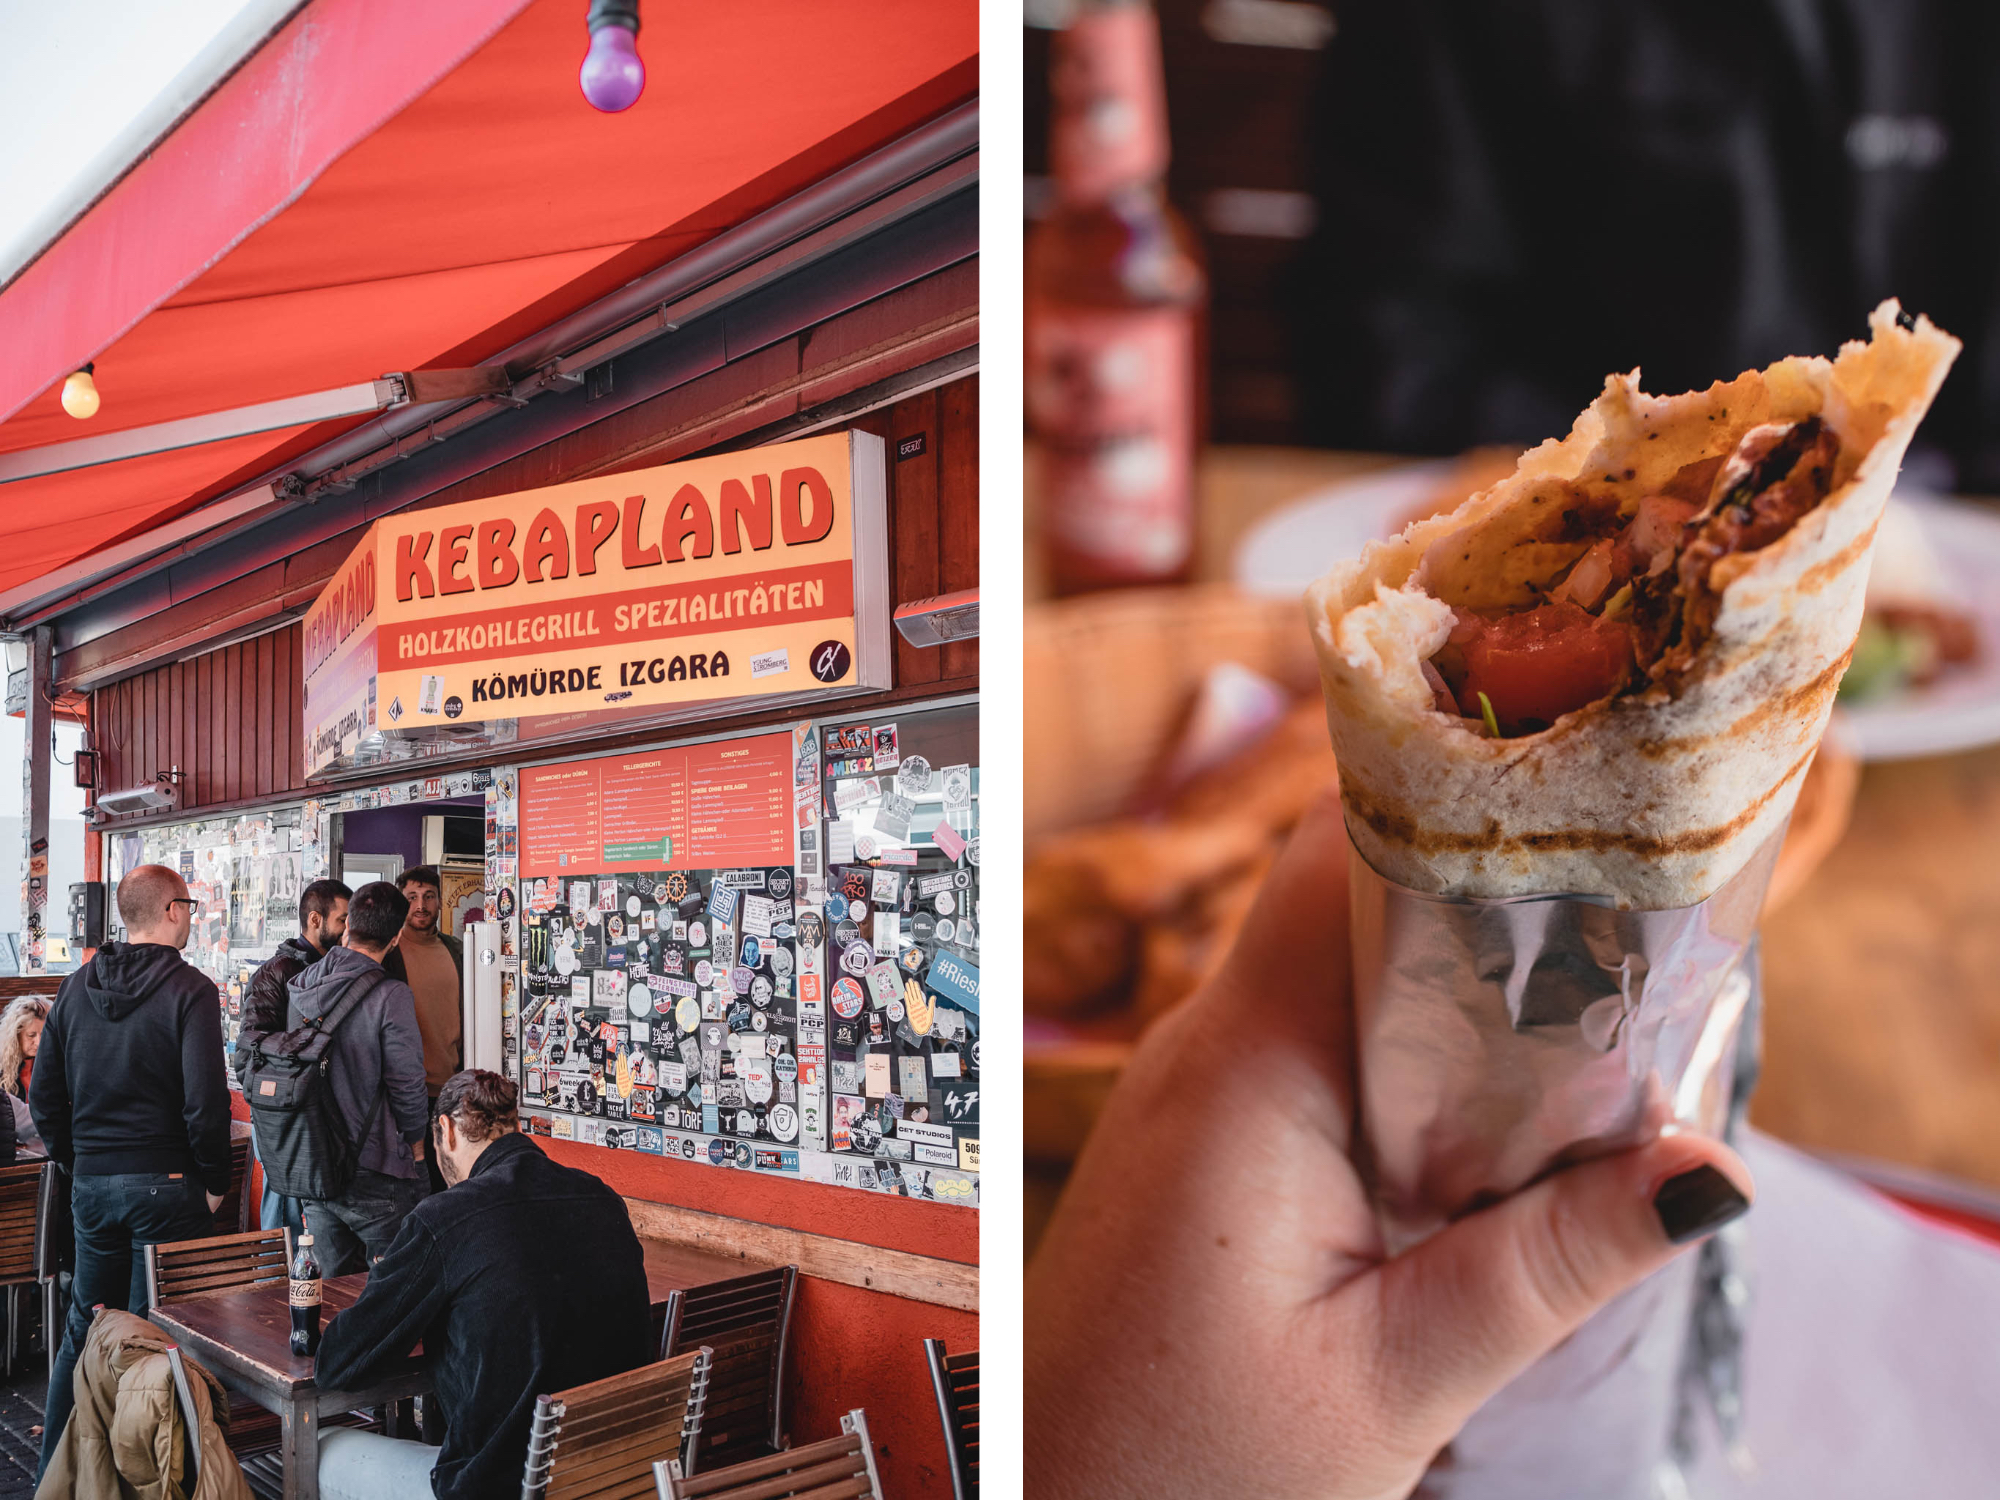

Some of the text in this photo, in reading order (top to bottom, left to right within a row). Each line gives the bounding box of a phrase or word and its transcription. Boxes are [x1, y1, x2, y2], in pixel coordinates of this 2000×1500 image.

[395, 466, 834, 604] KEBAPLAND
[305, 550, 376, 682] KEBAPLAND
[398, 579, 824, 659] HOLZKOHLEGRILL SPEZIALITÄTEN
[472, 650, 730, 702] KÖMÜRDE IZGARA
[721, 749, 749, 758] SONSTIGES
[623, 761, 662, 771] TELLERGERICHTE
[826, 757, 874, 777] AMIGOZ
[426, 780, 440, 795] AJJ
[726, 872, 762, 883] CALABRONI
[843, 870, 865, 885] 100
[840, 884, 866, 899] PRO
[768, 906, 791, 917] PCP
[265, 912, 289, 928] Claire
[658, 976, 697, 990] FEINSTAUB
[657, 982, 697, 998] TERRORIST
[832, 992, 852, 1003] RHEIN
[842, 998, 863, 1010] STARS
[800, 1019, 824, 1027] PCP
[797, 1047, 825, 1056] SEKTION
[776, 1064, 797, 1073] KATHRIN
[915, 1128, 951, 1140] STUDIOS
[665, 1138, 680, 1147] FCK
[665, 1145, 680, 1154] NZS
[925, 1148, 952, 1160] Polaroid
[757, 1155, 776, 1165] PUNK
[969, 1155, 980, 1164] Sü
